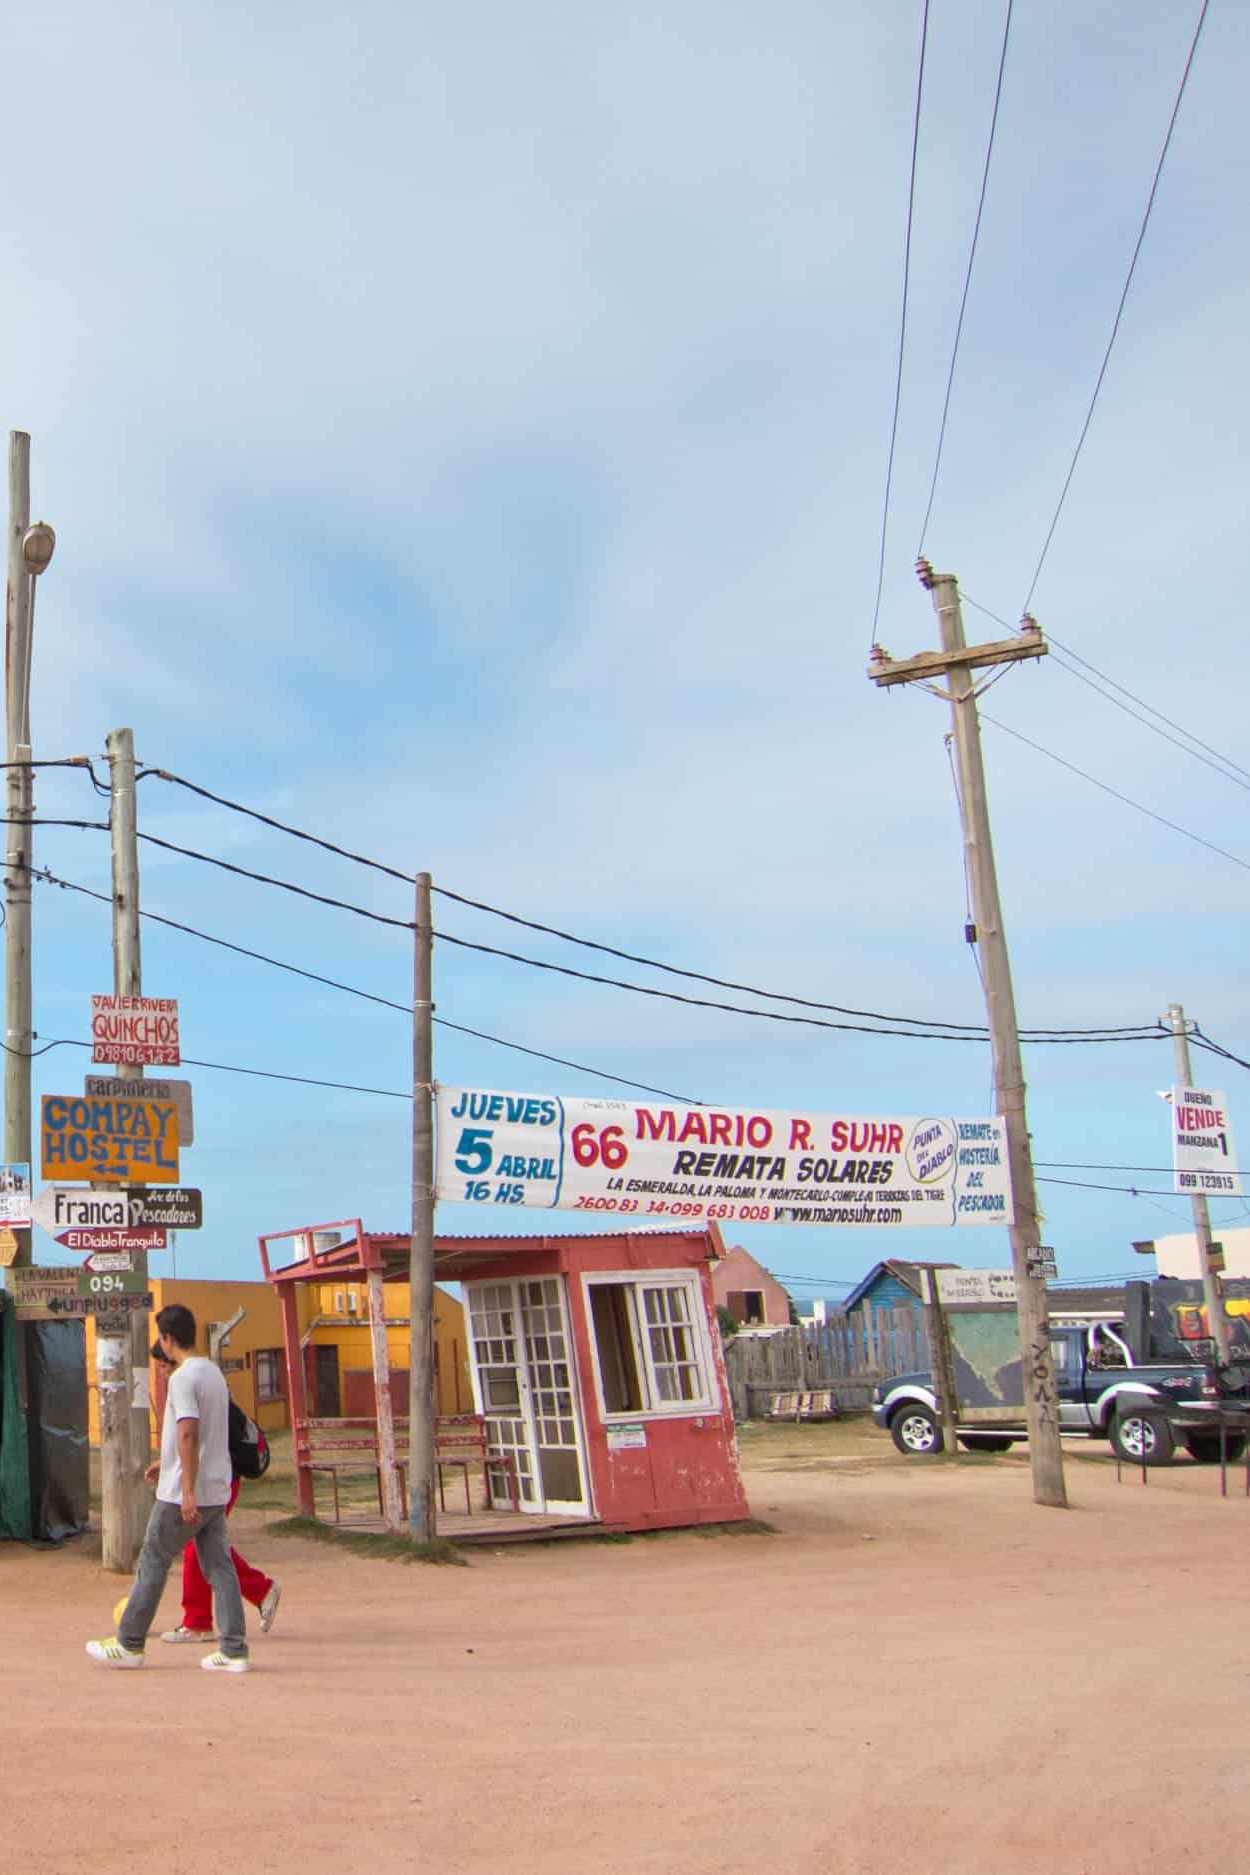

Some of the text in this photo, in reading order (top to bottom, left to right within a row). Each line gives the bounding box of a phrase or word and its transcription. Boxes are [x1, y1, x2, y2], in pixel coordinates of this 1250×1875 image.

[93, 1014, 178, 1044] QUINCHOS
[45, 1098, 174, 1137] COMPAY
[451, 1092, 557, 1126] JUEVES
[1177, 1106, 1225, 1131] VENDE
[635, 1108, 904, 1154] MARIO R. SUHR
[913, 1124, 942, 1150] PUNTA
[958, 1123, 991, 1141] REMATE
[45, 1132, 176, 1168] HOSTEL
[455, 1128, 558, 1180] 5 ABRIL
[571, 1123, 629, 1170] 66
[1177, 1132, 1228, 1156] MANZANA 1
[673, 1150, 894, 1184] REMATA SOLARES
[916, 1150, 929, 1164] DEL
[919, 1143, 954, 1179] DIABLO
[607, 1177, 624, 1191] LA
[714, 1186, 756, 1199] PALOMA
[759, 1188, 765, 1200] Y
[966, 1171, 984, 1188] DEL
[1180, 1173, 1197, 1187] 099
[464, 1181, 526, 1204] 16 HS.
[957, 1194, 1006, 1211] PESCADOR
[55, 1192, 124, 1225] Franca
[129, 1197, 197, 1226] Pescadores
[574, 1196, 618, 1210] 2600
[739, 1206, 770, 1220] 008
[68, 1231, 165, 1250] El Diablo Tranquilo
[90, 1275, 124, 1292] 094
[62, 1293, 153, 1314] unplugged
